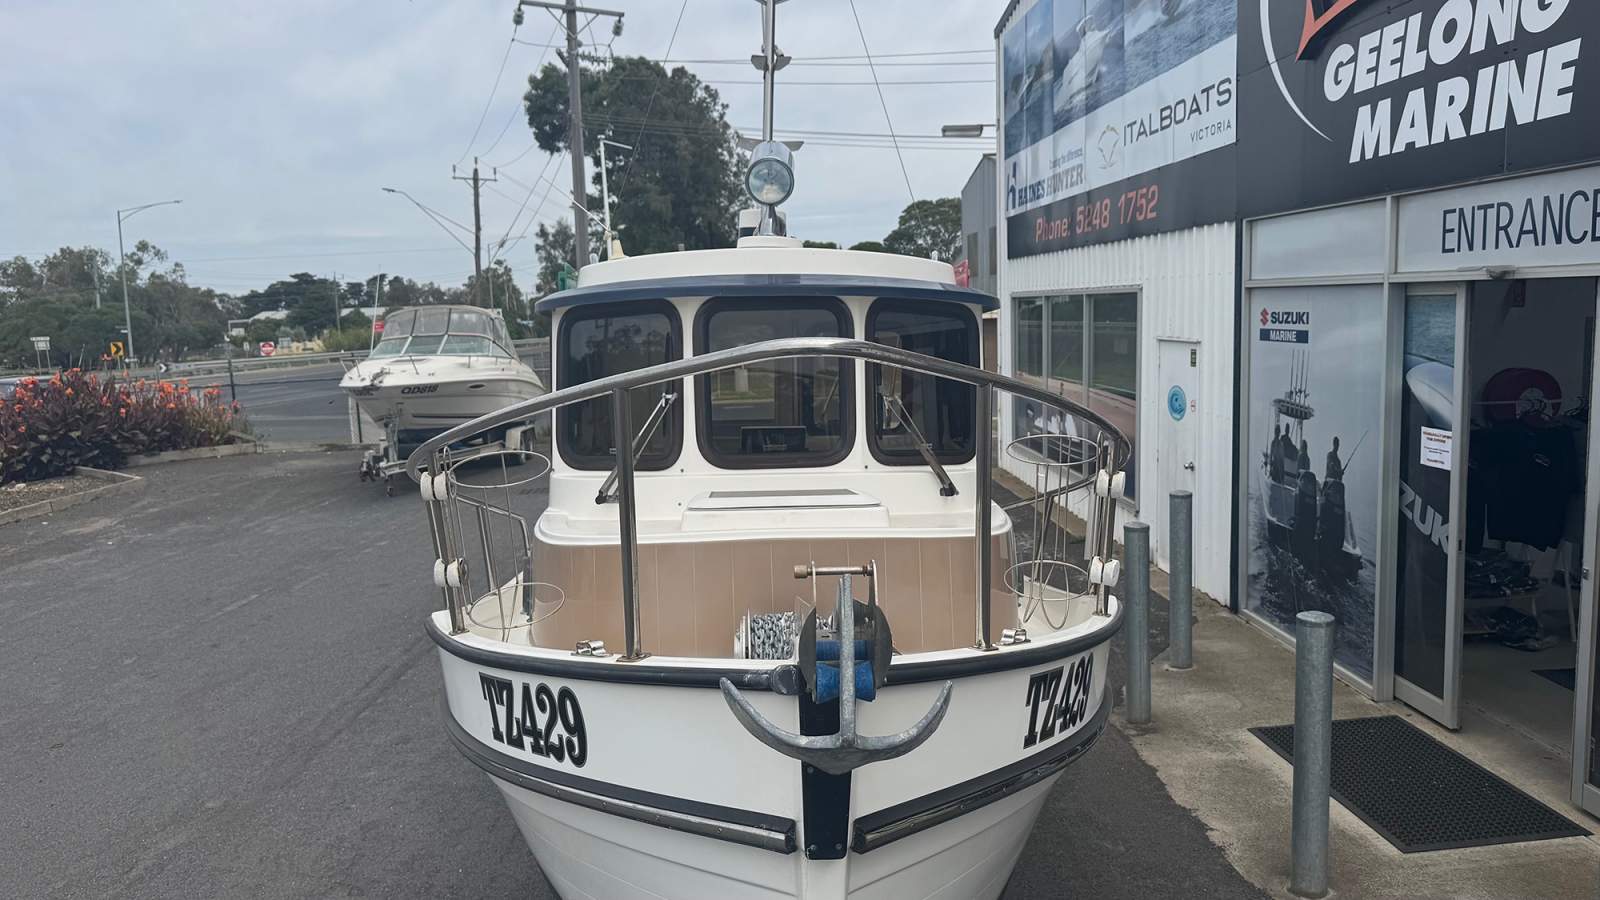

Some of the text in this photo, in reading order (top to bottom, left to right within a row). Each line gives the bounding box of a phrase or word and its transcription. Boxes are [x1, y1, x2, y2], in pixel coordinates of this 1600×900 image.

[1323, 0, 1570, 102] GEELONG
[1123, 77, 1232, 147] ITALBOATS
[1190, 119, 1232, 143] VICTORIA
[1349, 37, 1582, 164] MARINE
[1018, 163, 1084, 207] HAINES HUNTER
[1035, 184, 1159, 243] Phone: 5248 1752
[1441, 188, 1600, 254] ENTRANCE
[1270, 311, 1309, 324] SUZUKI
[1270, 329, 1297, 342] MARINE
[479, 671, 588, 768] TZ429
[1023, 651, 1094, 749] TZ429
